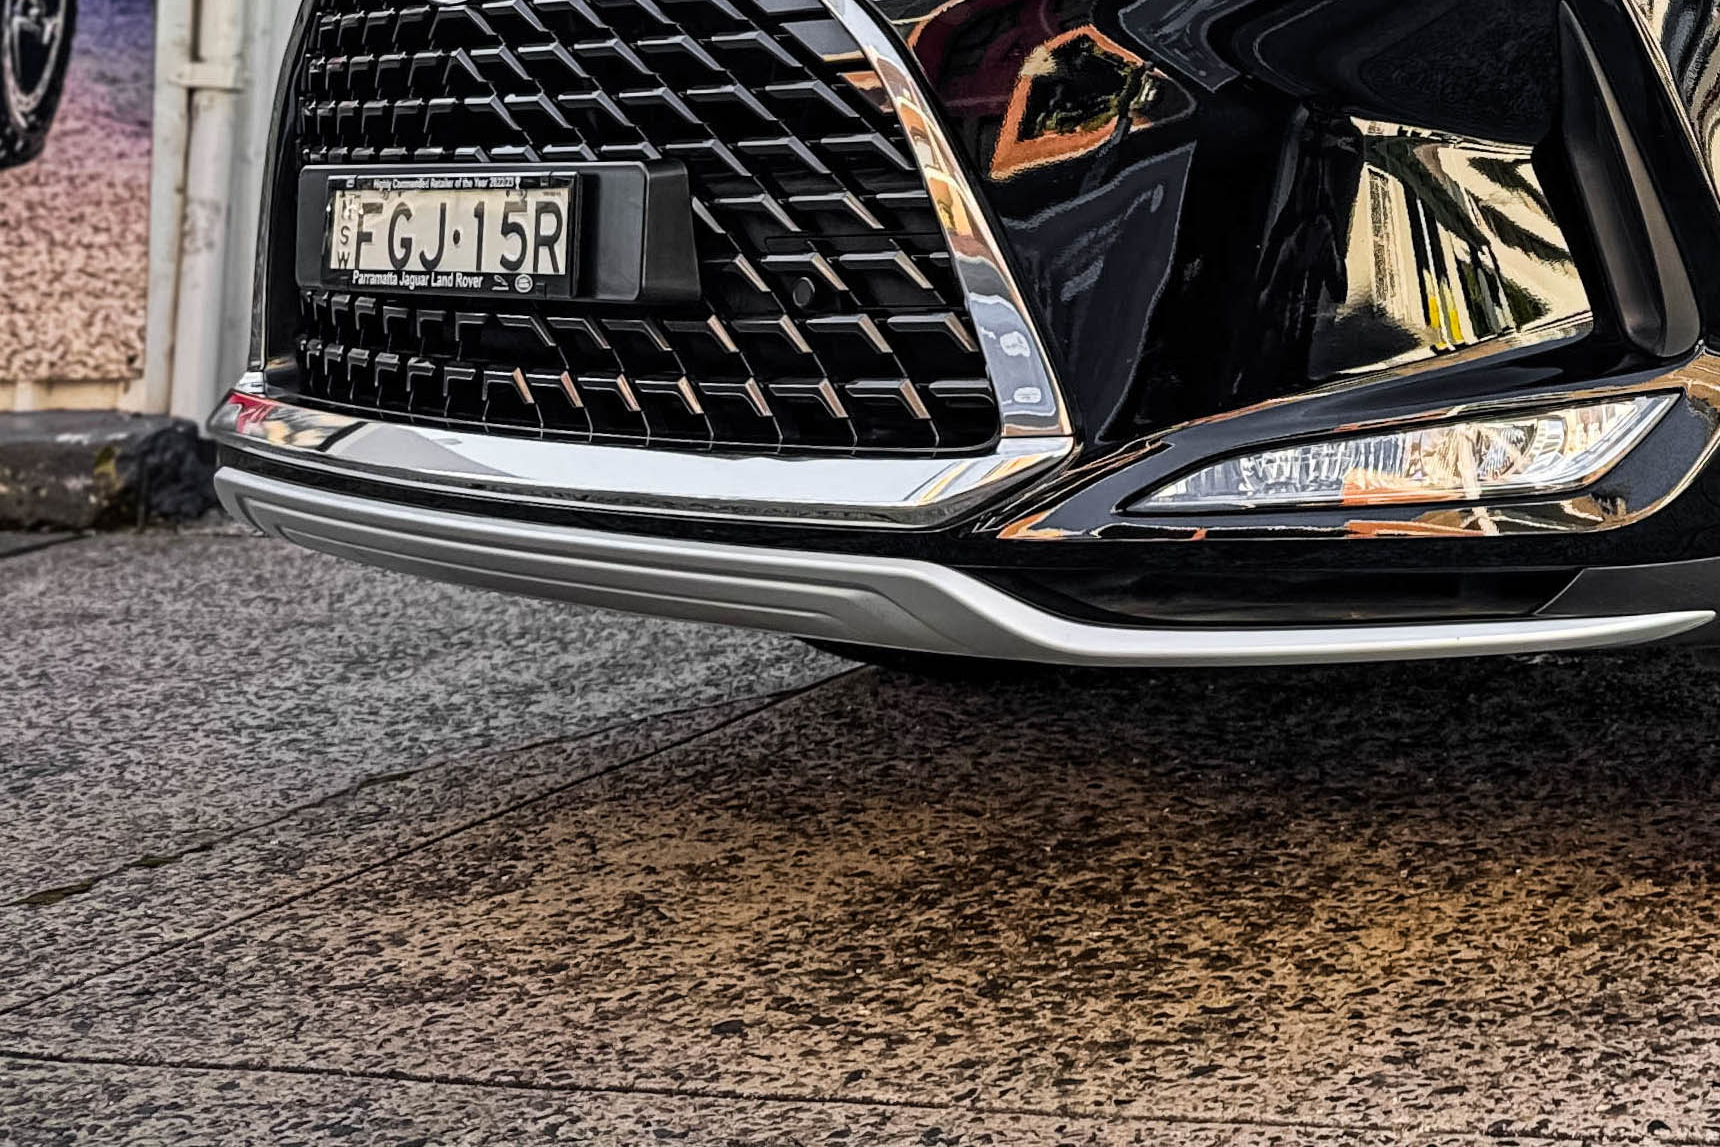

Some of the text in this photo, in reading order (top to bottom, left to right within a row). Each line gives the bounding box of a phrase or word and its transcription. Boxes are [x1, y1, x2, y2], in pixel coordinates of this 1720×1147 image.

[373, 178, 392, 191] Highly
[392, 178, 430, 189] Commended
[430, 178, 454, 189] Retailer
[474, 178, 489, 188] Year
[352, 270, 484, 290] Parramatta Jaguar Land Rover
